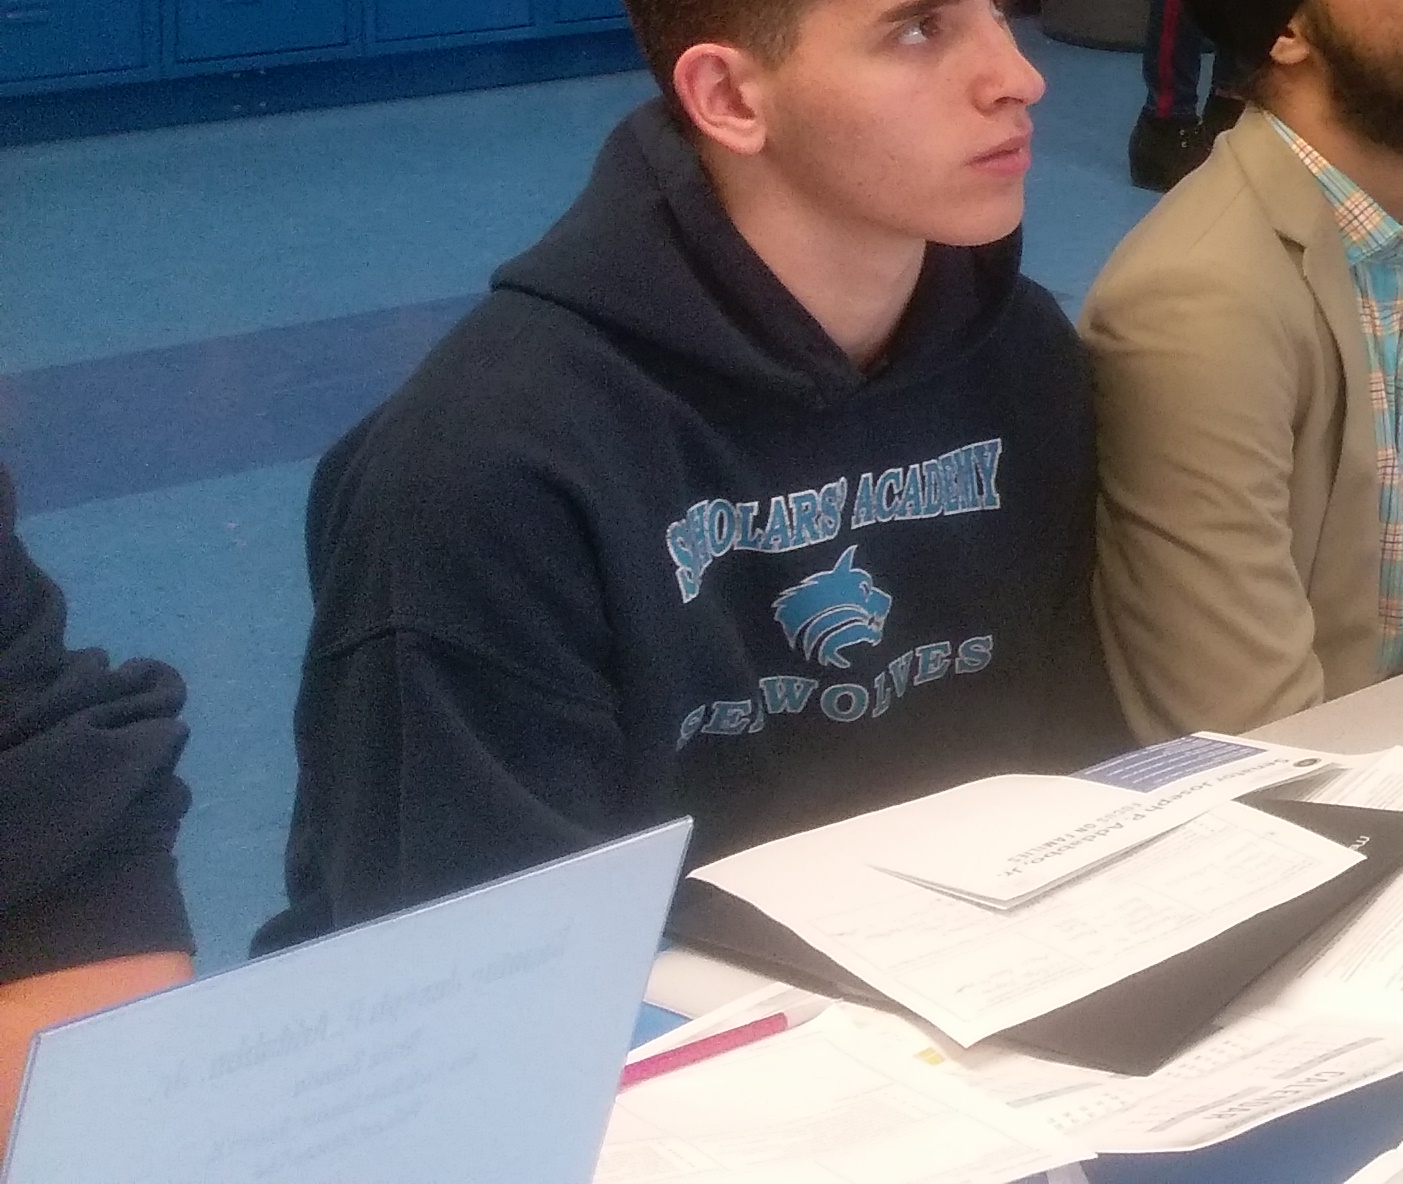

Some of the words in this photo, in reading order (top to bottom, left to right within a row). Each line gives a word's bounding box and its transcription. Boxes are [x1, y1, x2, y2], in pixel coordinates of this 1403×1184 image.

[850, 437, 1002, 530] ACADEMY
[1145, 780, 1214, 813] Joseph
[1073, 822, 1098, 834] ON
[1007, 832, 1076, 863] FAMILIES
